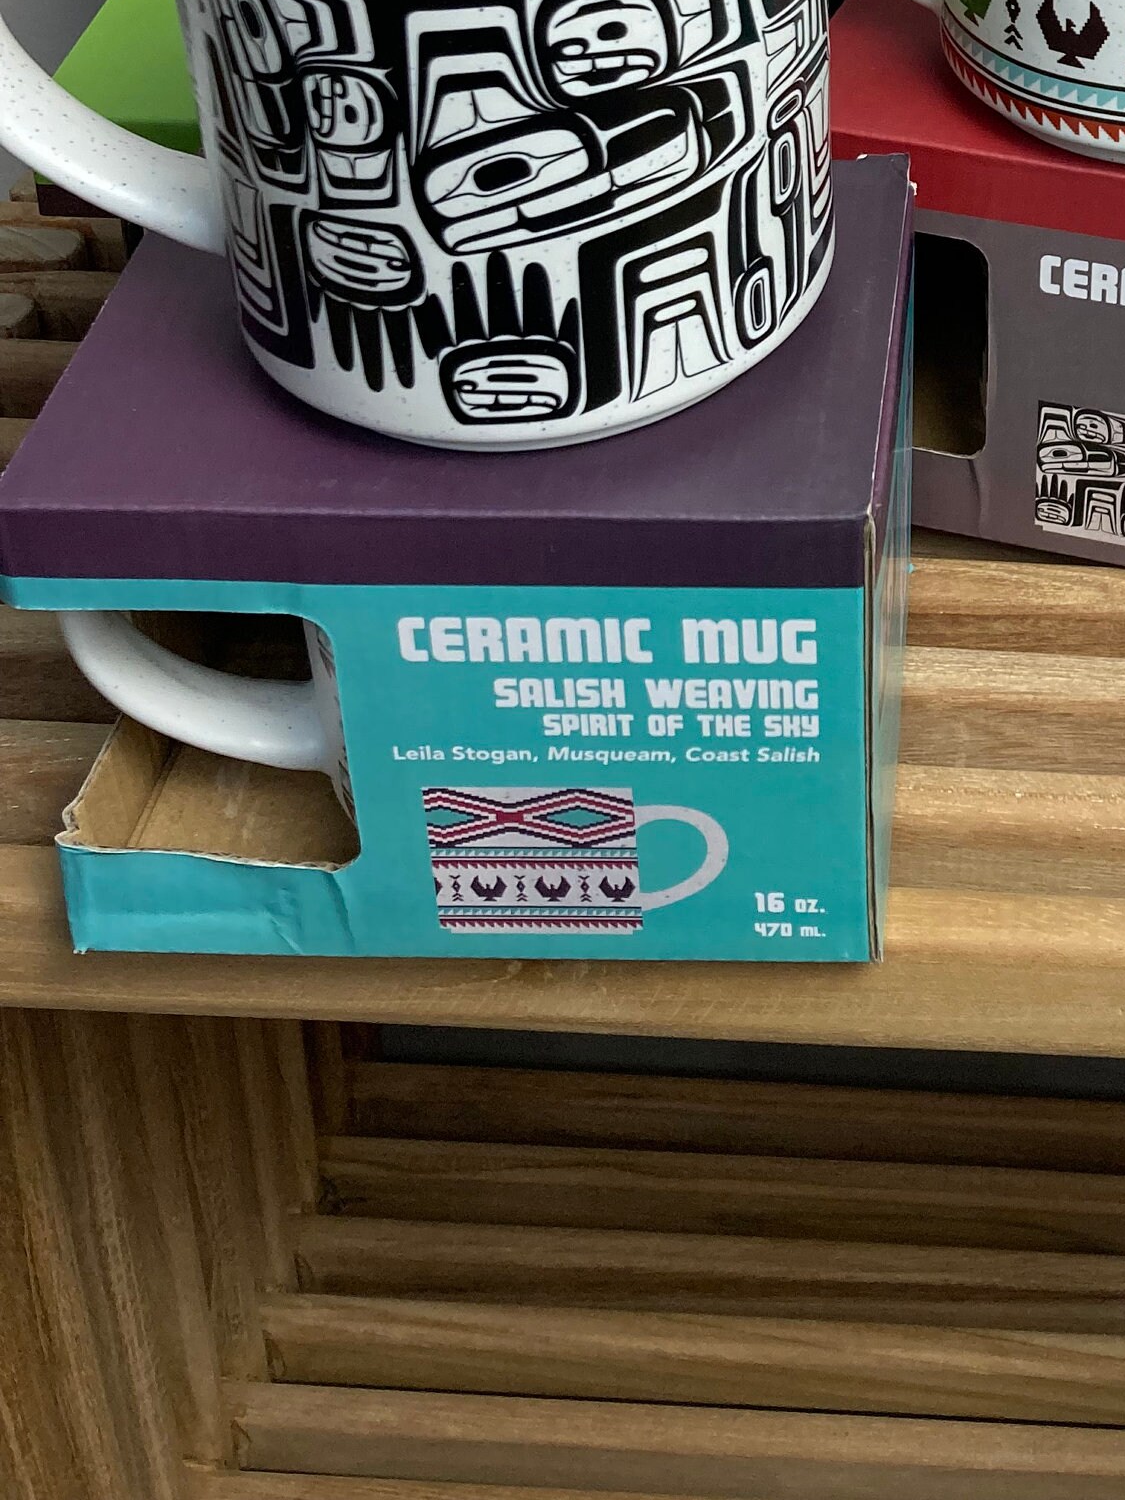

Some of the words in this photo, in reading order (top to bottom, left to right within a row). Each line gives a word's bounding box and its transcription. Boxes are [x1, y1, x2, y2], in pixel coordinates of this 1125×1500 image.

[398, 617, 653, 664] CERAMIC
[682, 618, 817, 665] MUG
[493, 678, 626, 709] SALISH
[645, 679, 818, 710] WEAVING
[543, 714, 634, 737] SPIRIT
[647, 714, 684, 737] OF
[697, 715, 751, 737] THE
[764, 715, 819, 738] SKY
[393, 746, 445, 761] Leila
[451, 746, 538, 766] Stogan,
[547, 747, 677, 766] Musqueam,
[685, 747, 750, 763] Coast
[757, 747, 820, 764] Salish
[754, 892, 785, 913] 16
[754, 923, 792, 936] 470
